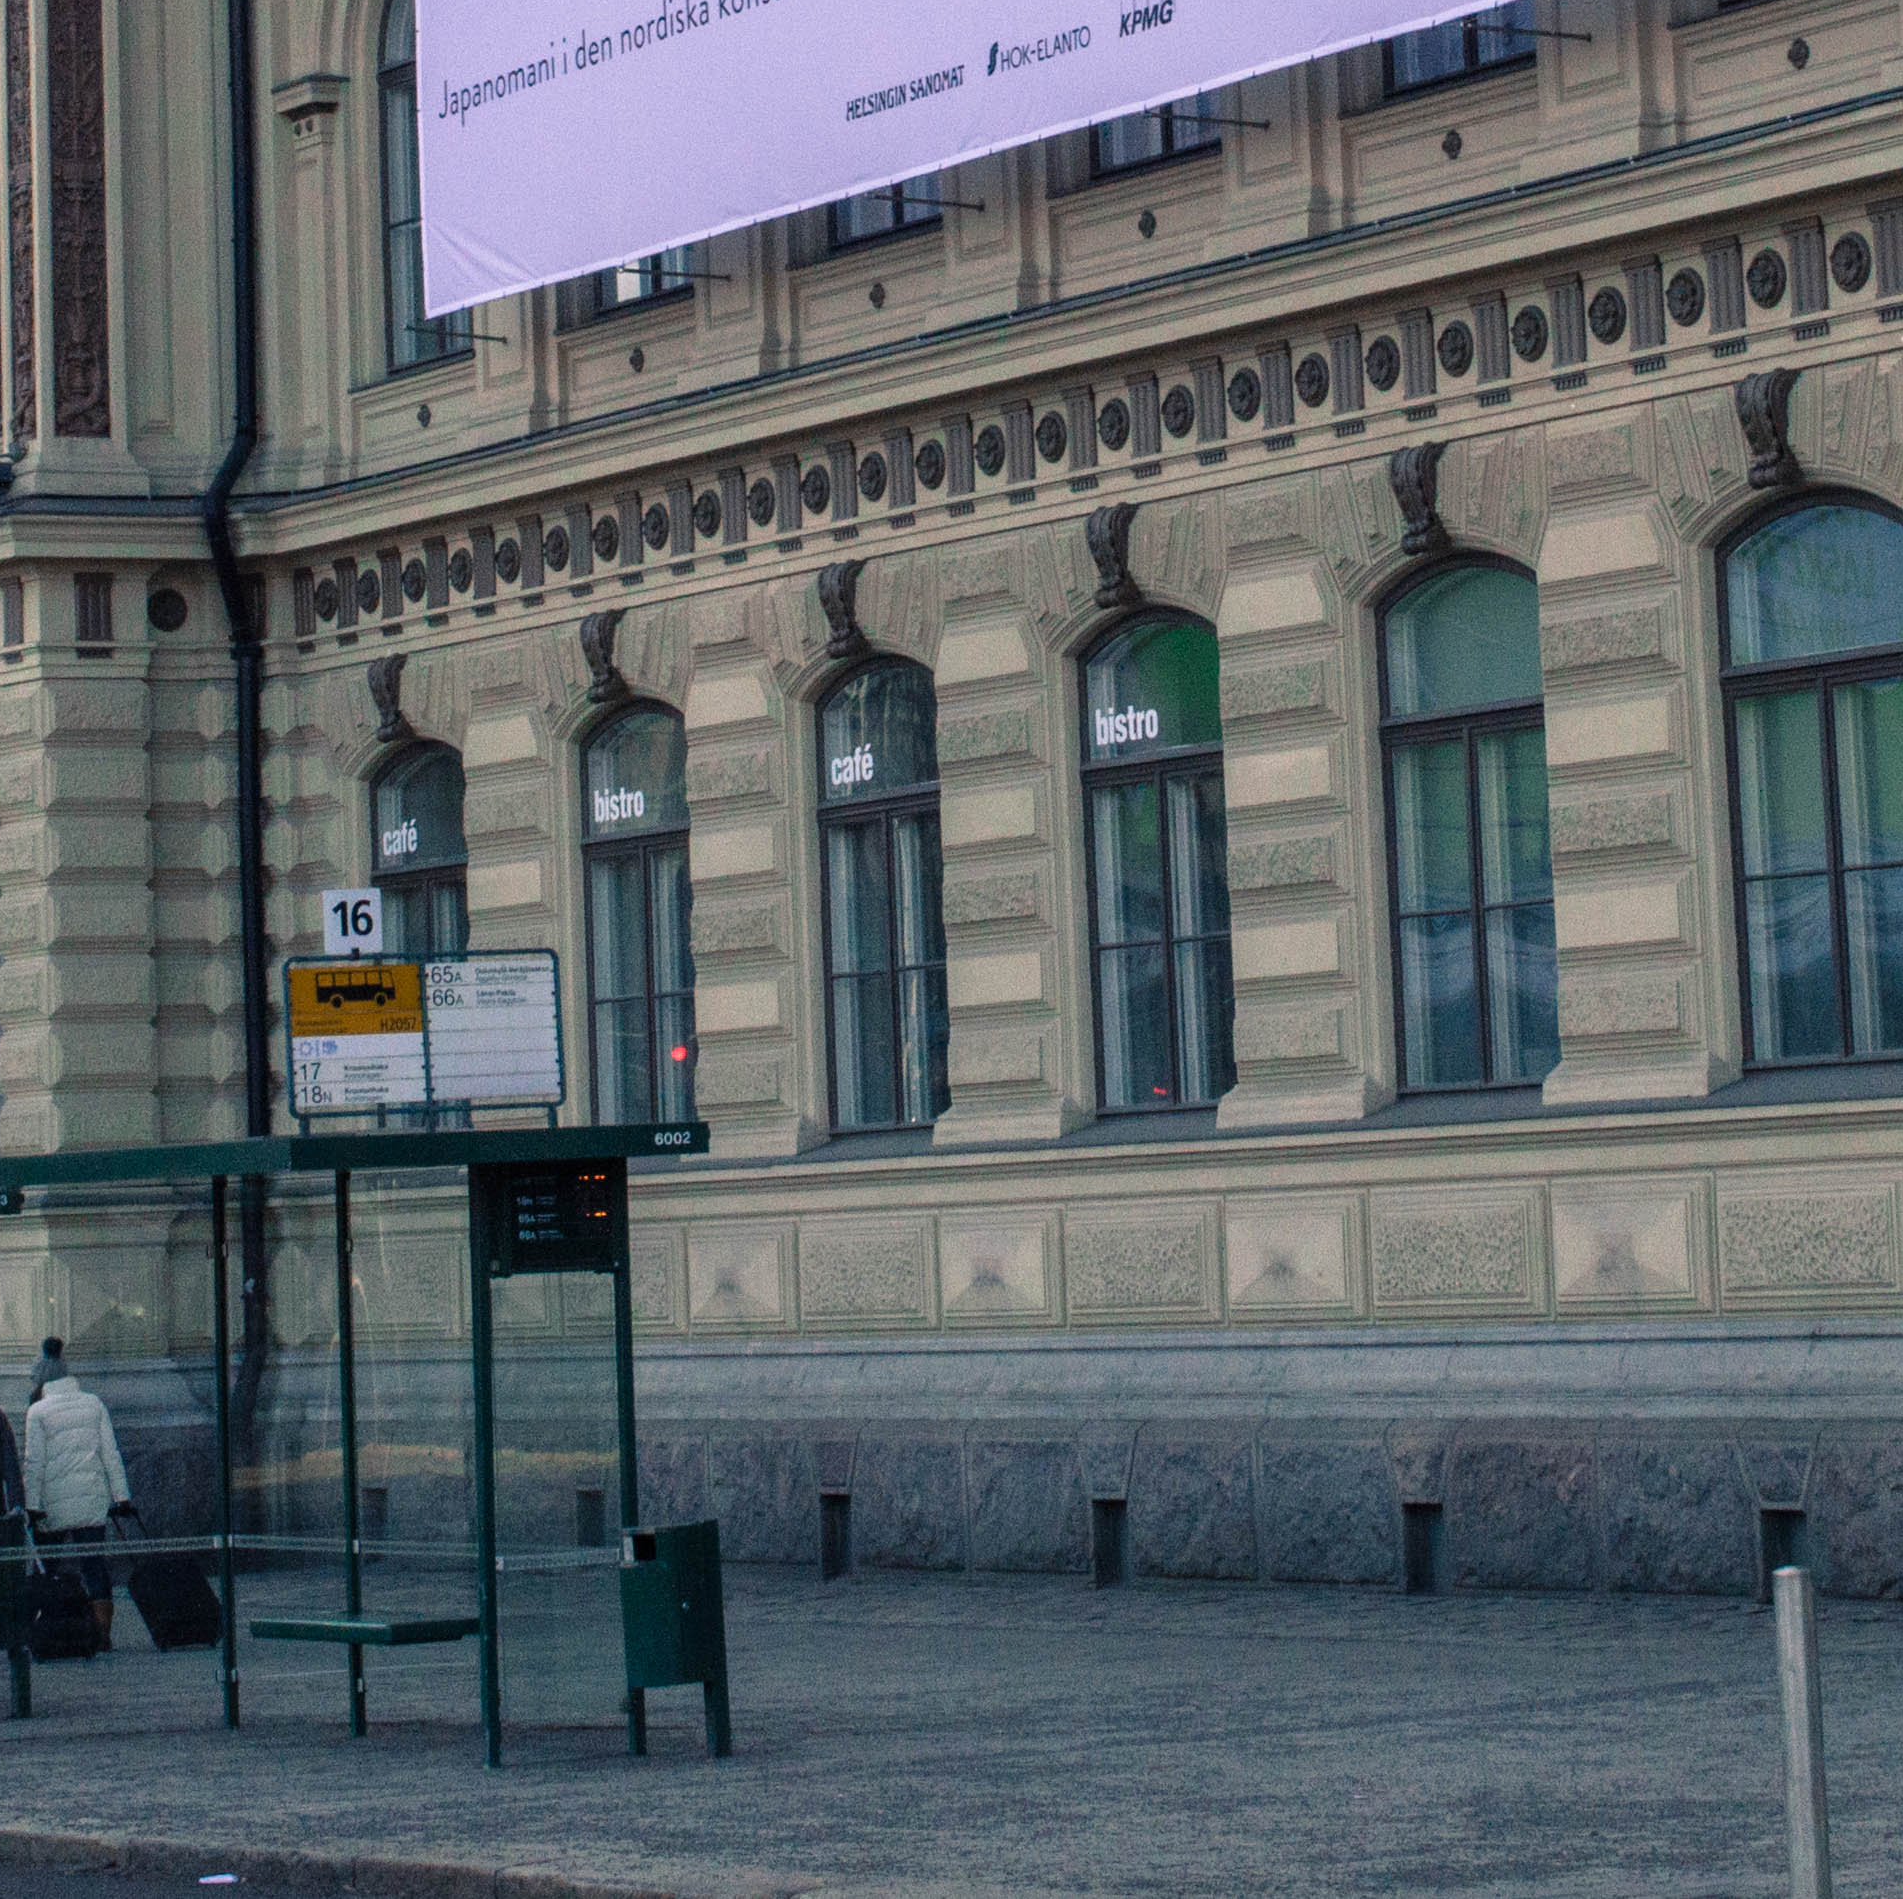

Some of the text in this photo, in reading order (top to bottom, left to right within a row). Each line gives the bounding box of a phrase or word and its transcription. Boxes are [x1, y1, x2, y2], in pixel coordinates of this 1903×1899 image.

[1120, 0, 1174, 38] KPMG
[1001, 26, 1092, 72] HOK-ELANTO
[438, 41, 556, 127] Japanomani
[561, 37, 569, 75] i
[575, 29, 613, 73] den
[846, 65, 965, 121] HELSINGIN SANOMAT
[1093, 705, 1159, 747] bistro
[831, 743, 873, 786] café
[593, 786, 644, 824] bistro
[382, 821, 418, 858] café
[333, 899, 373, 937] 16
[299, 1062, 321, 1081] 17
[654, 1131, 691, 1146] 6002
